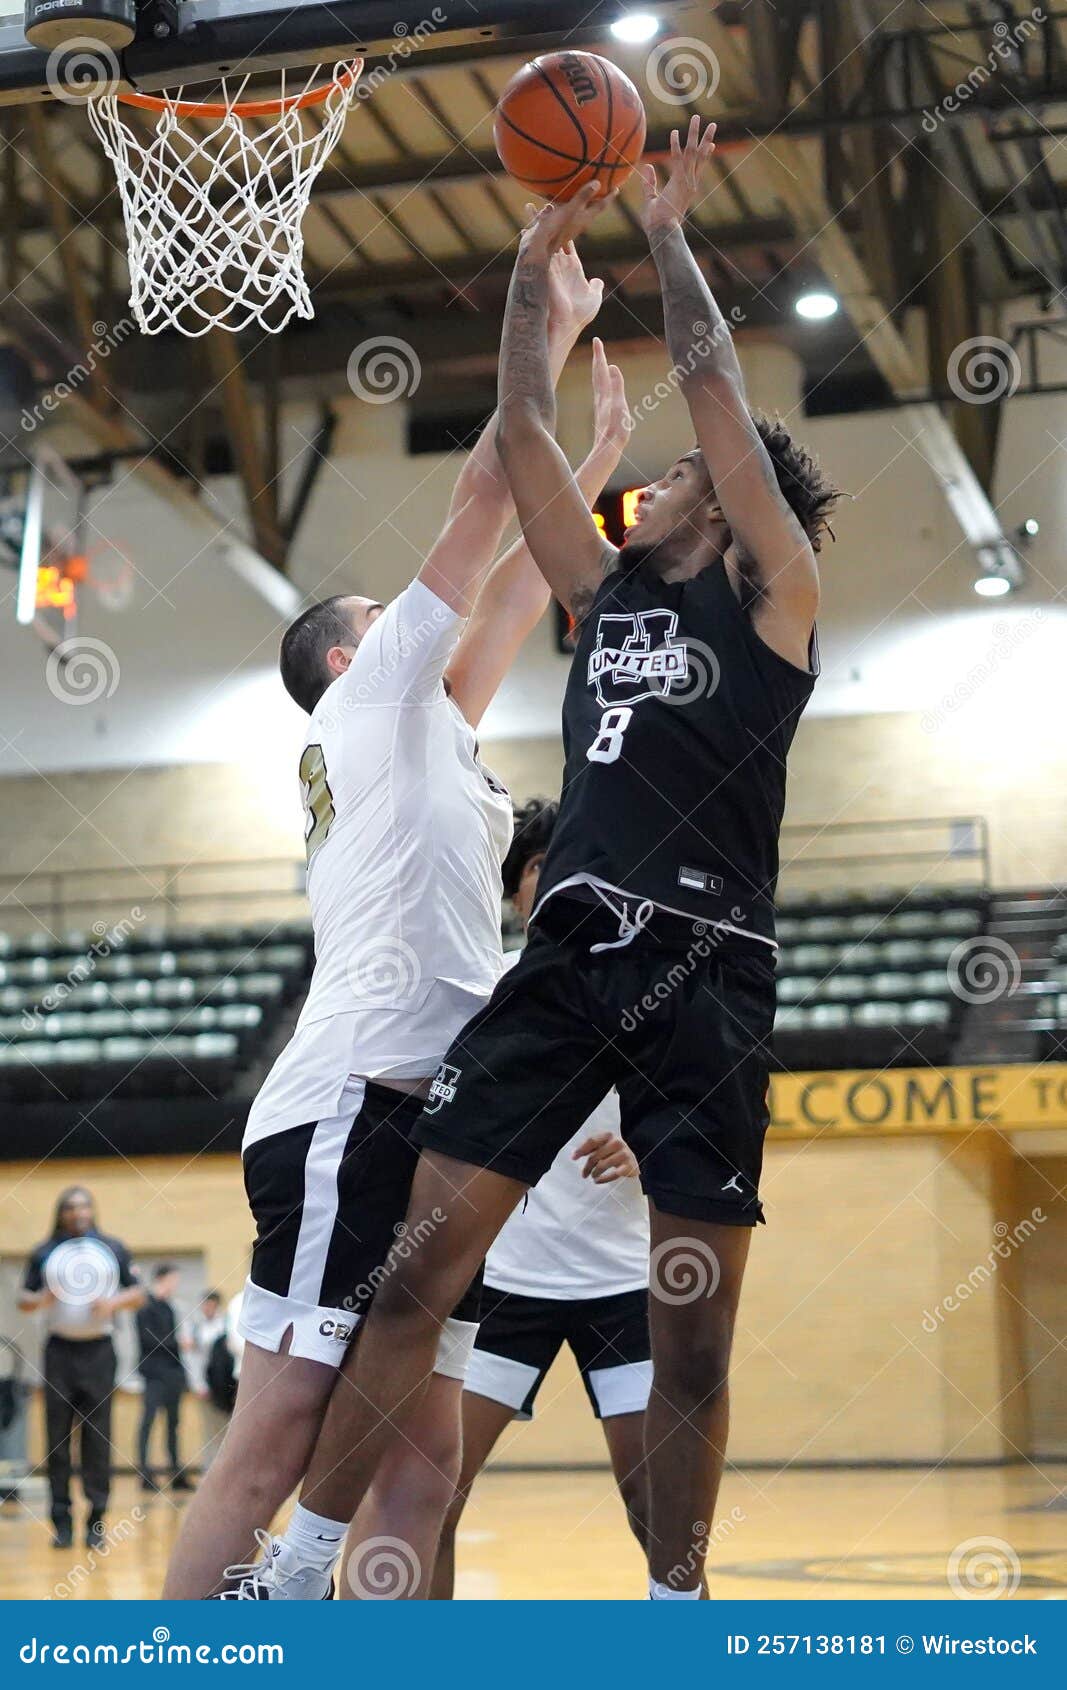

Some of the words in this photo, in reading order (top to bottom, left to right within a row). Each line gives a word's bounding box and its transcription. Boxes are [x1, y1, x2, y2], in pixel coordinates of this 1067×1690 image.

[592, 651, 680, 673] UNITED
[586, 706, 634, 764] 8
[711, 879, 716, 889] L
[769, 1073, 1004, 1127] LCOME
